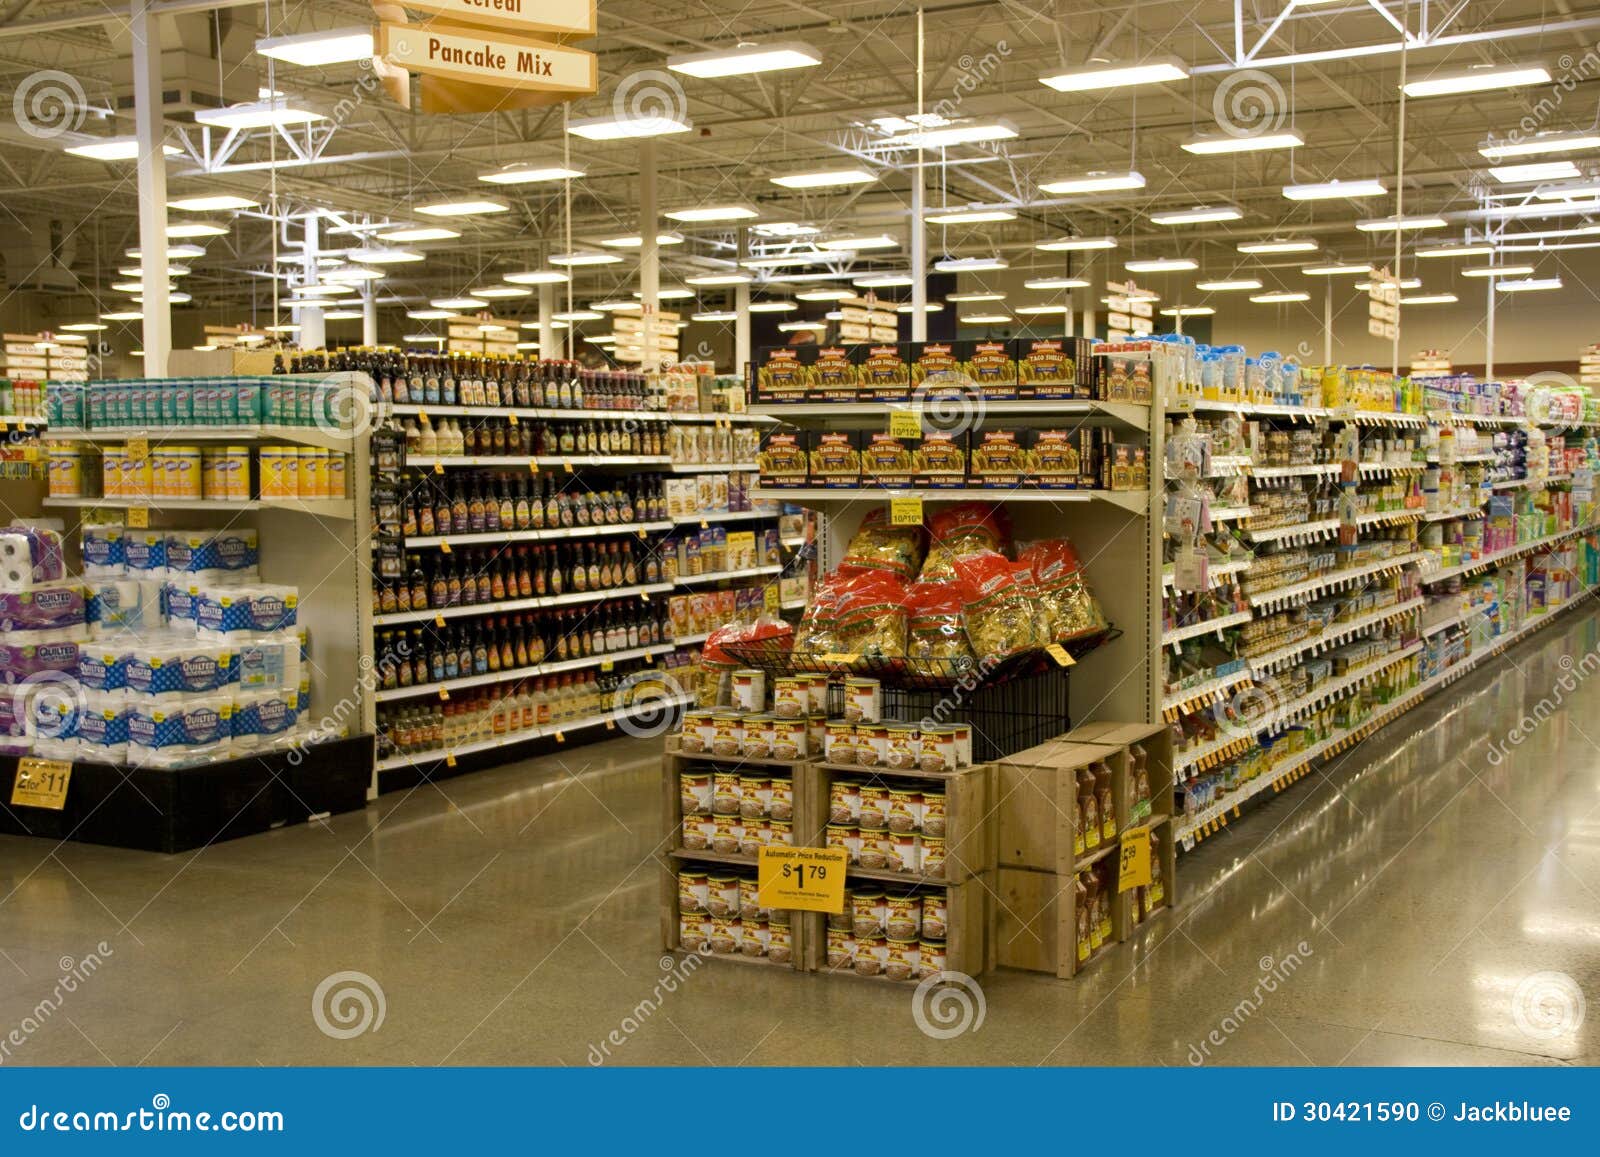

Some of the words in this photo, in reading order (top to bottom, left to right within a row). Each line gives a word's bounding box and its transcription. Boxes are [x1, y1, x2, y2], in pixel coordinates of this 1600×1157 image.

[464, 0, 520, 12] real
[428, 38, 506, 70] Pancake
[517, 52, 552, 76] Mix
[815, 853, 842, 861] Reduction
